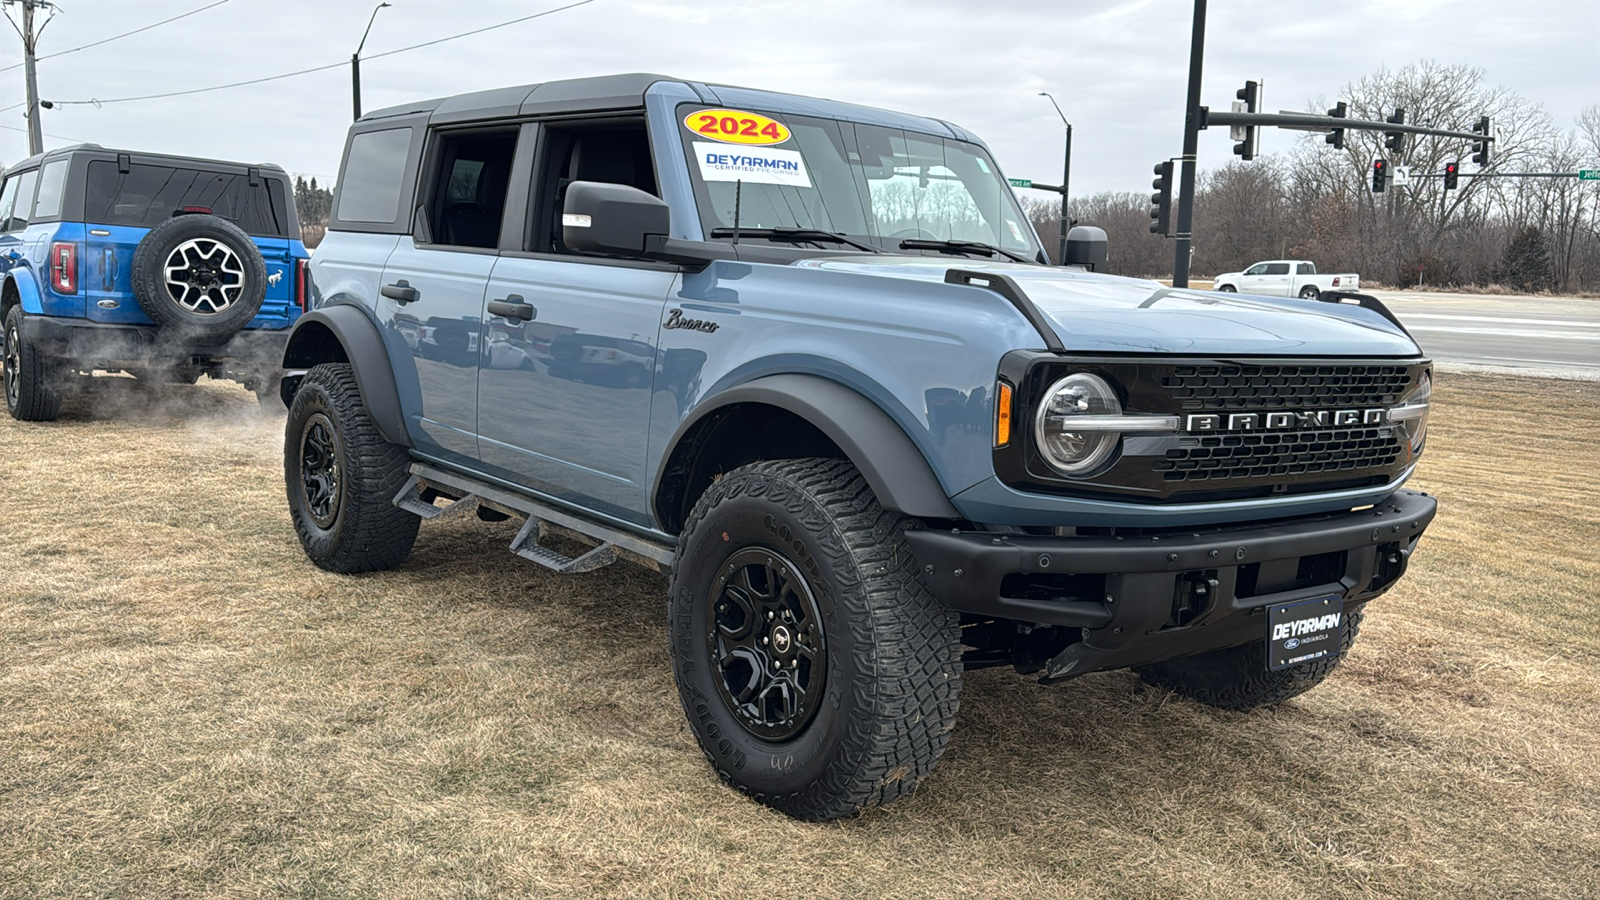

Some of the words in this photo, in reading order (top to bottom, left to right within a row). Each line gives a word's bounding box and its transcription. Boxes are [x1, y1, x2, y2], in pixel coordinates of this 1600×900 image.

[698, 114, 780, 140] 2024
[705, 153, 799, 171] DEYARMAN
[714, 164, 754, 172] CERTIFIED
[756, 167, 799, 176] PRE-OWNED
[662, 308, 720, 333] Bronco
[1187, 408, 1387, 432] BRONCO
[1272, 612, 1341, 640] DEYARMAN
[1300, 633, 1329, 644] INDIANOLA
